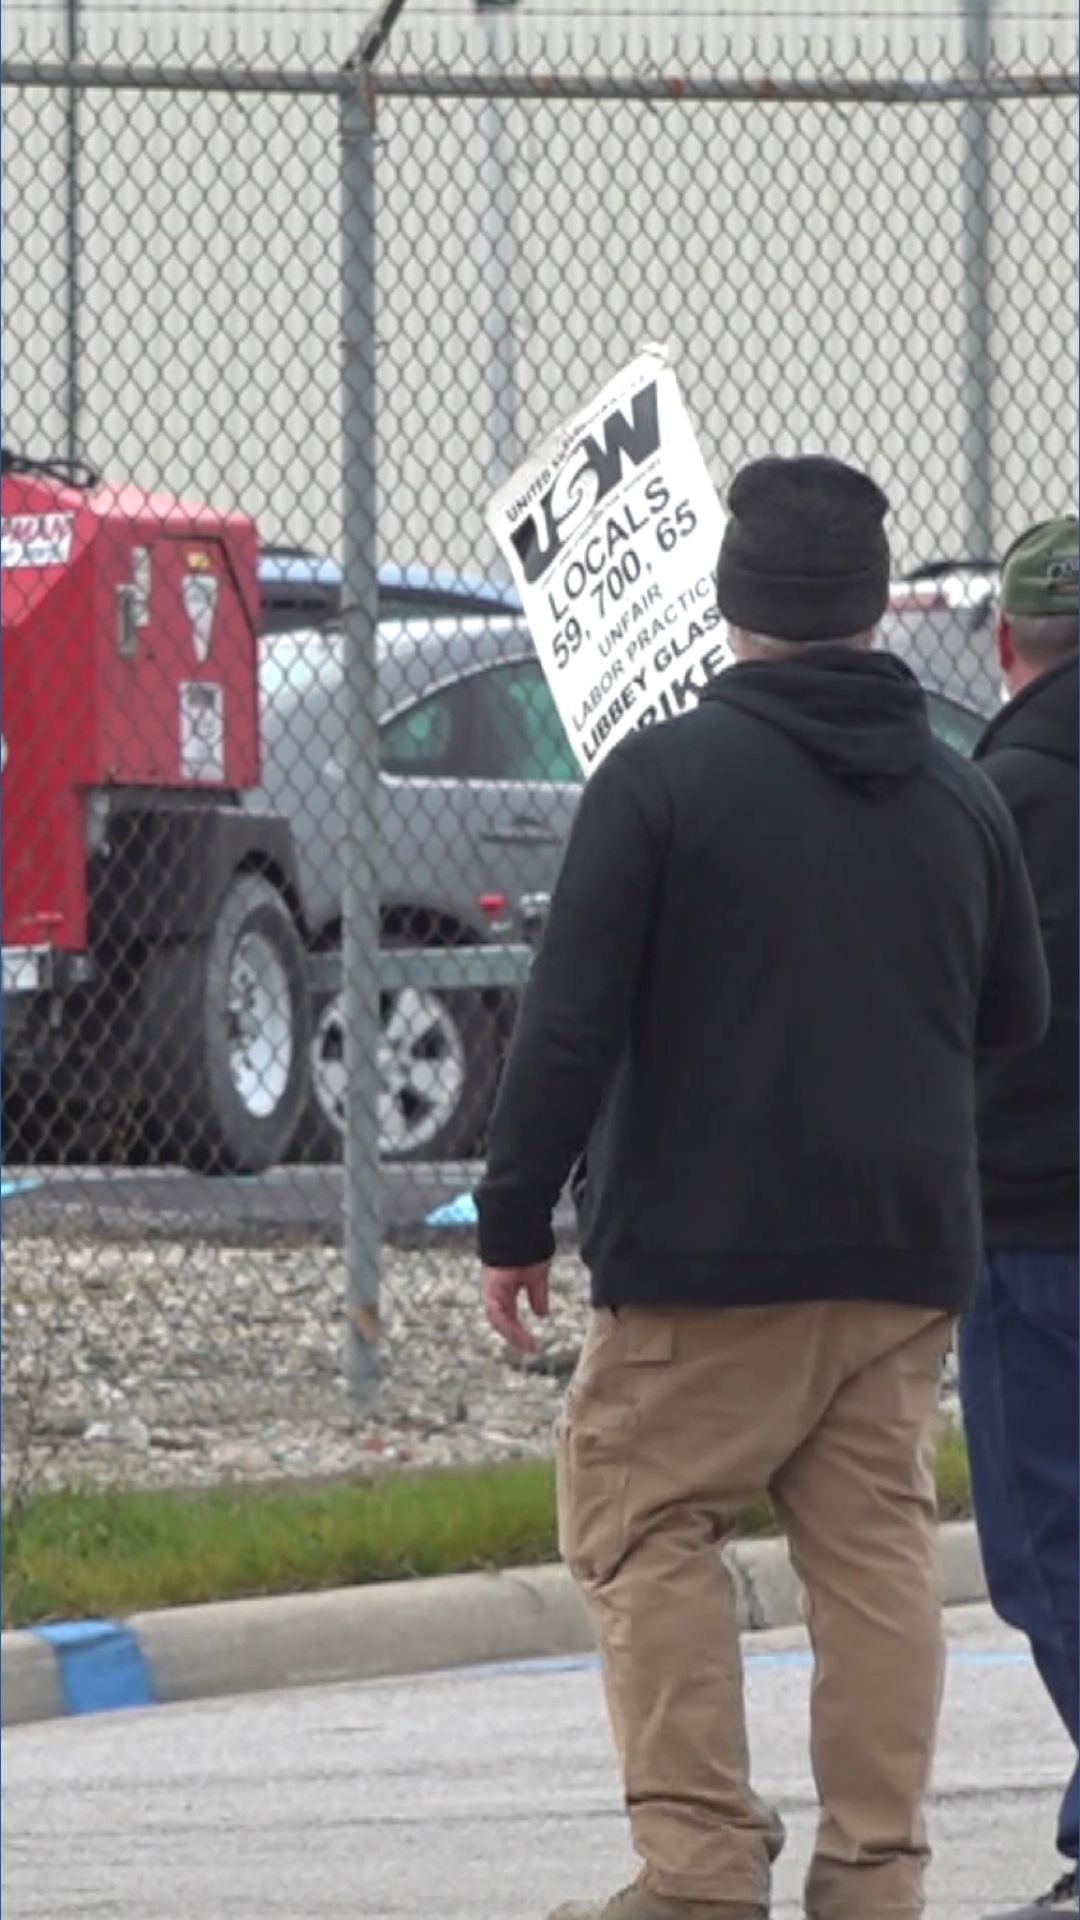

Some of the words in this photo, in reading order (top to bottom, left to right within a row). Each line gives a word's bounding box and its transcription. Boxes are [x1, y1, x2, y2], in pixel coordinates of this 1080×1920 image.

[506, 470, 552, 522] UNITED
[548, 476, 670, 623] LOCALS
[552, 617, 592, 670] 59,
[590, 549, 653, 619] 700,
[656, 499, 698, 552] 65
[598, 583, 663, 657] UNFAIR
[572, 659, 625, 733] LABOR
[581, 666, 649, 762] LIBBEY
